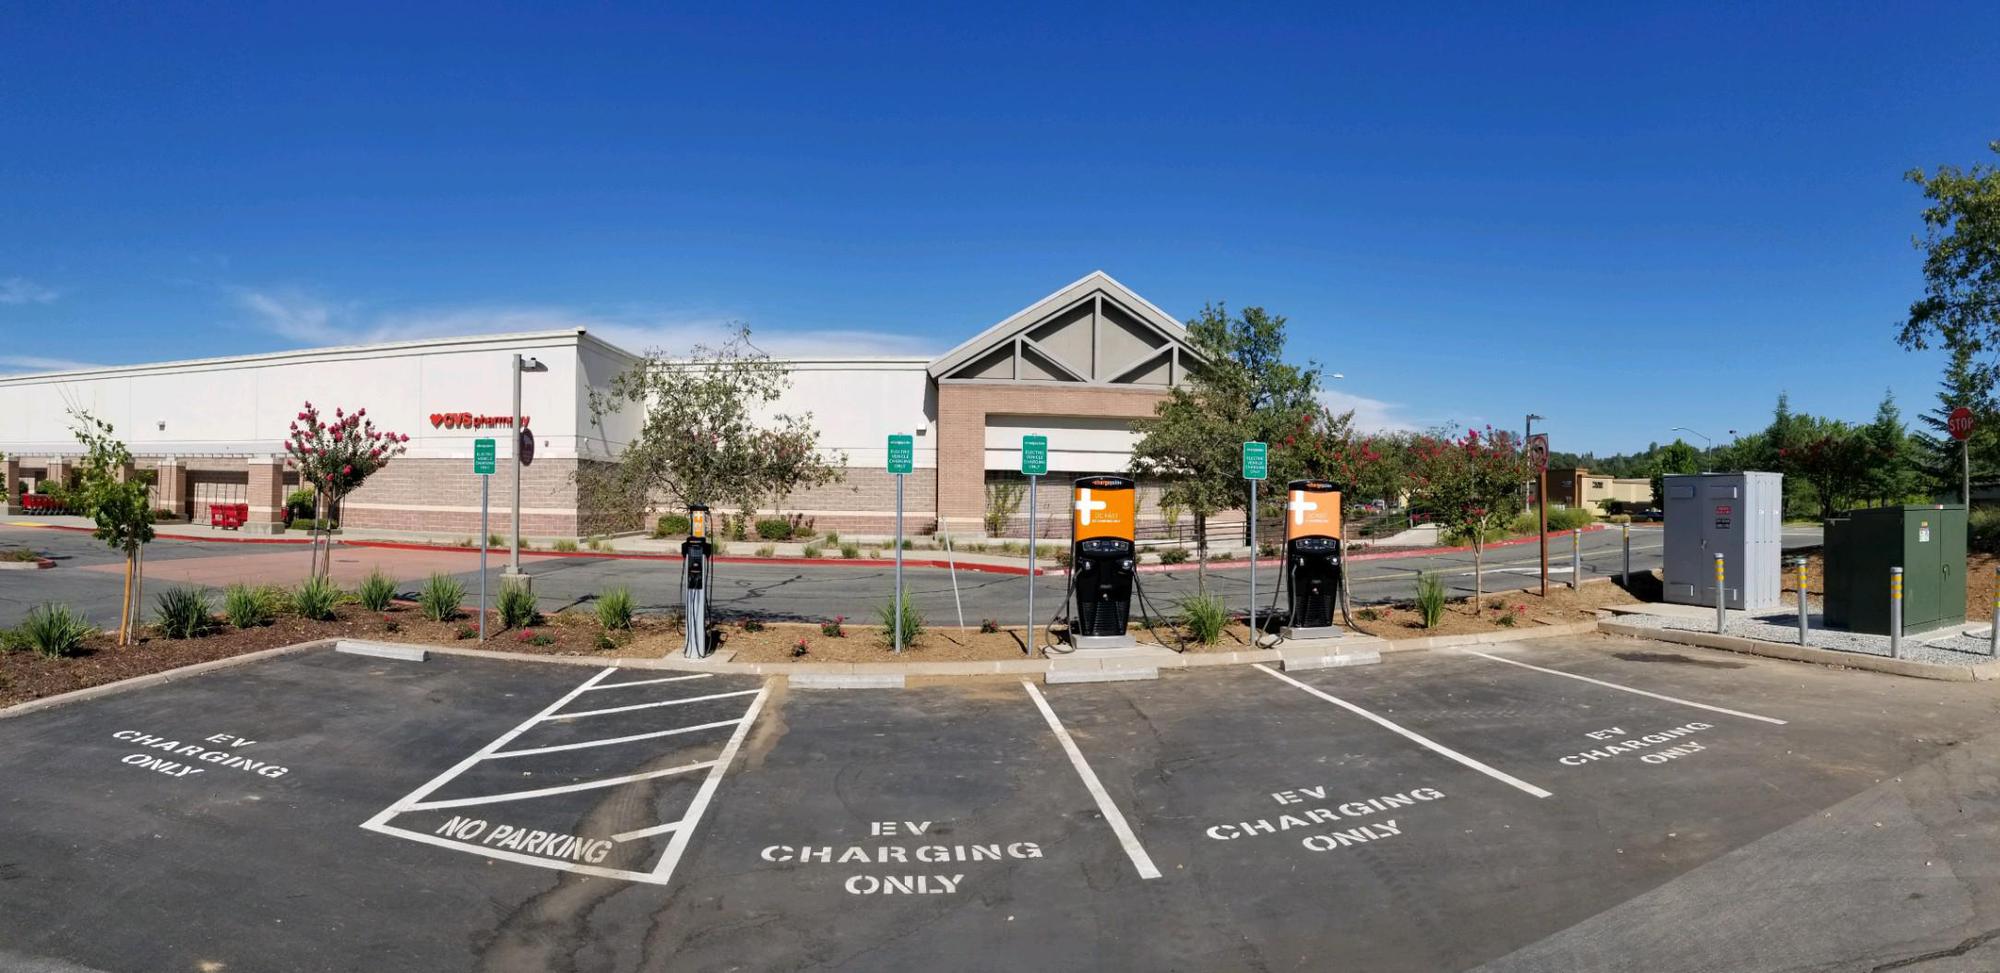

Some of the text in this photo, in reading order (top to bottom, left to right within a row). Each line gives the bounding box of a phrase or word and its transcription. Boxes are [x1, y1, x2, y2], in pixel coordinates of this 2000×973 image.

[444, 412, 530, 431] CVS pharmay
[1949, 417, 1974, 431] STOP
[205, 733, 256, 747] EV
[1559, 722, 1714, 765] CHARGING
[1585, 726, 1627, 740] EV
[112, 730, 289, 778] CHARGING
[1640, 741, 1706, 764] ONLY
[121, 753, 205, 777] ONLY
[1271, 785, 1326, 805] EV
[1206, 788, 1446, 840] CHARGING
[871, 821, 932, 836] EV
[1302, 819, 1402, 851] ONLY
[435, 816, 612, 863] NO PARKING
[761, 842, 1043, 862] CHARGING
[845, 874, 964, 895] ONLY
